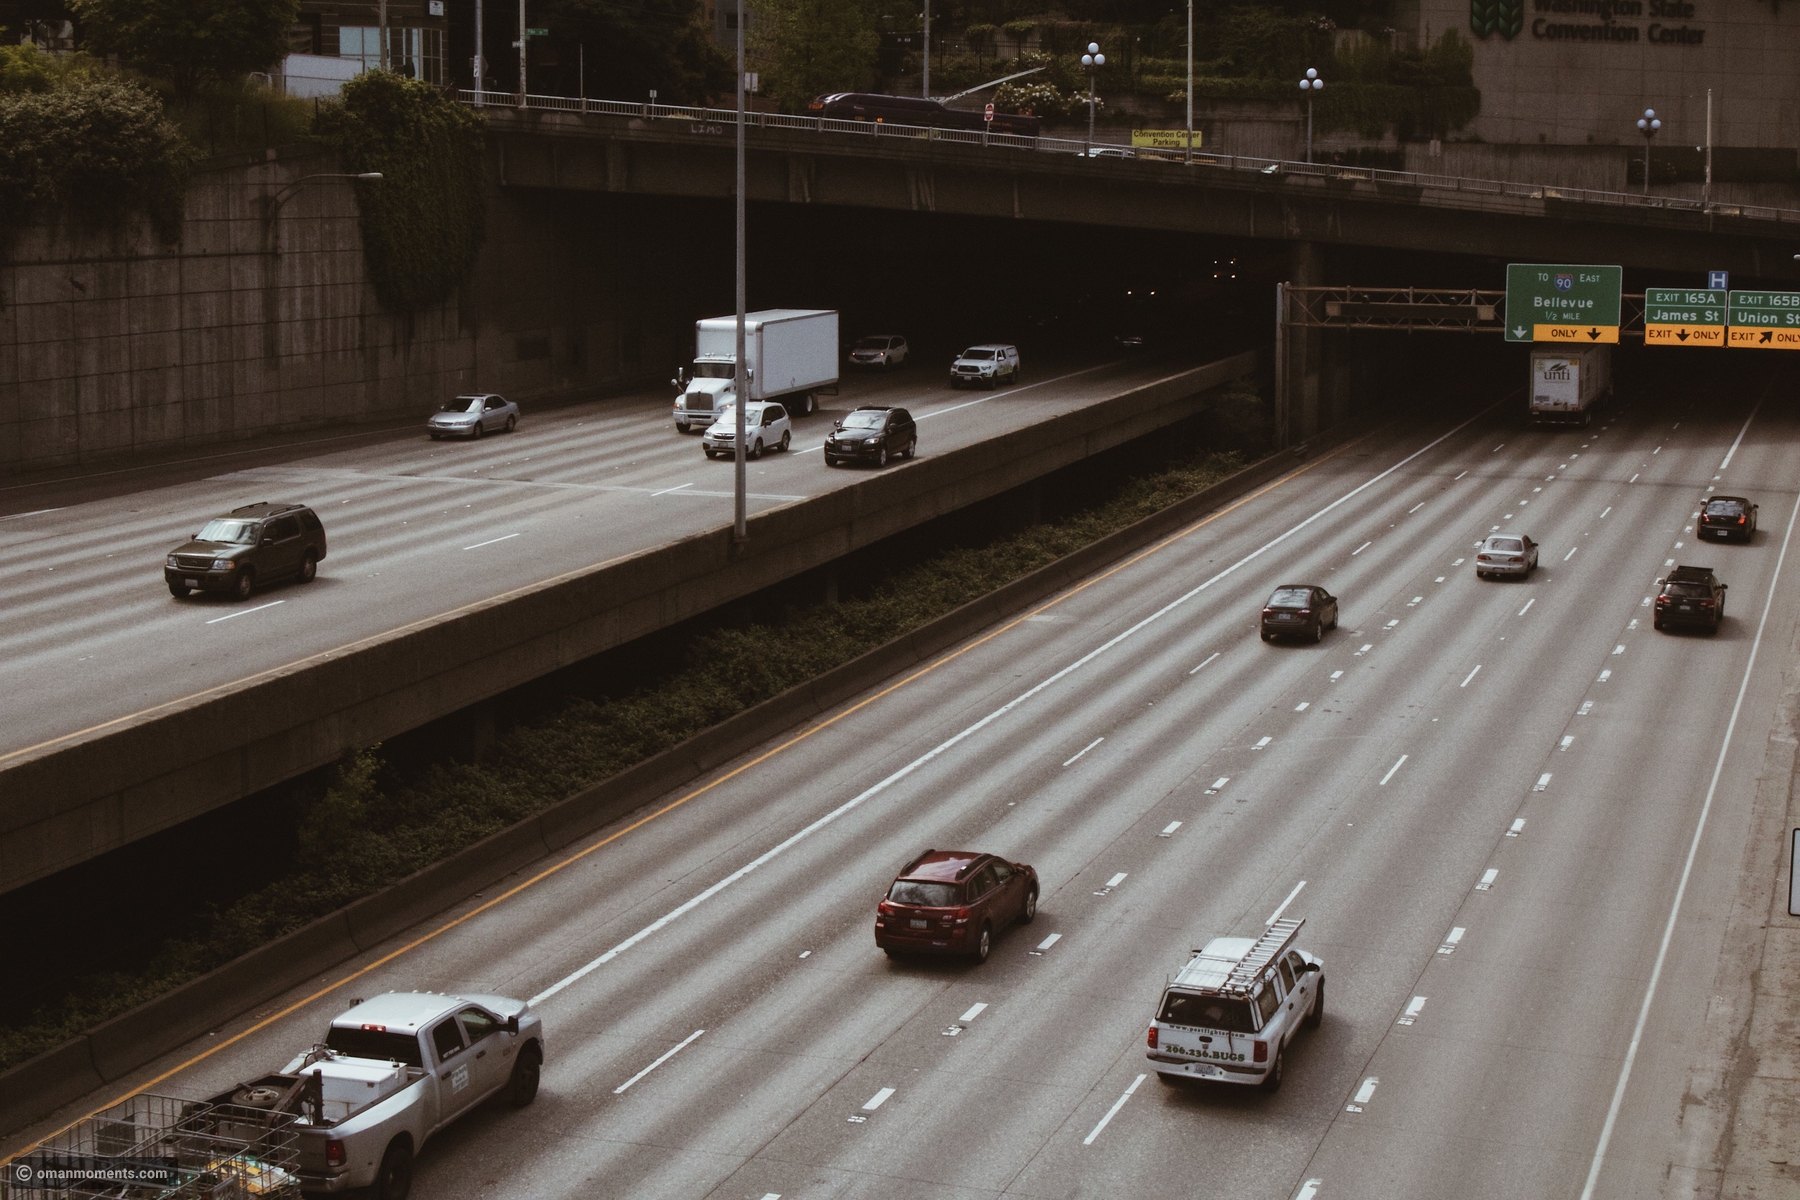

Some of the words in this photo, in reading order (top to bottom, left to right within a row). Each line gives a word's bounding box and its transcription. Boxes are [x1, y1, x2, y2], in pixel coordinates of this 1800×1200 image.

[1649, 0, 1695, 18] State
[1532, 18, 1639, 42] Convention
[1648, 23, 1706, 44] Center
[1133, 130, 1175, 138] Convention
[1152, 138, 1180, 147] Parking
[1538, 273, 1549, 282] TO
[1556, 278, 1571, 289] 90
[1579, 273, 1600, 283] EAST
[1711, 273, 1726, 288] H
[1533, 296, 1594, 308] Bellevue
[1656, 293, 1680, 302] EXIT
[1685, 293, 1716, 304] 165A
[1739, 295, 1764, 305] EXIT
[1768, 295, 1800, 307] 165B
[1562, 312, 1580, 320] MILE
[1653, 309, 1697, 321] James
[1704, 310, 1719, 322] St
[1738, 311, 1778, 324] Union
[1786, 312, 1800, 325] St
[1551, 328, 1578, 338] ONLY
[1648, 329, 1672, 339] EXIT
[1693, 331, 1720, 340] ONLY
[1731, 331, 1755, 341] EXIT
[1169, 1024, 1245, 1038] www.pestfightercom
[1165, 1045, 1245, 1062] 206.236.BUGS
